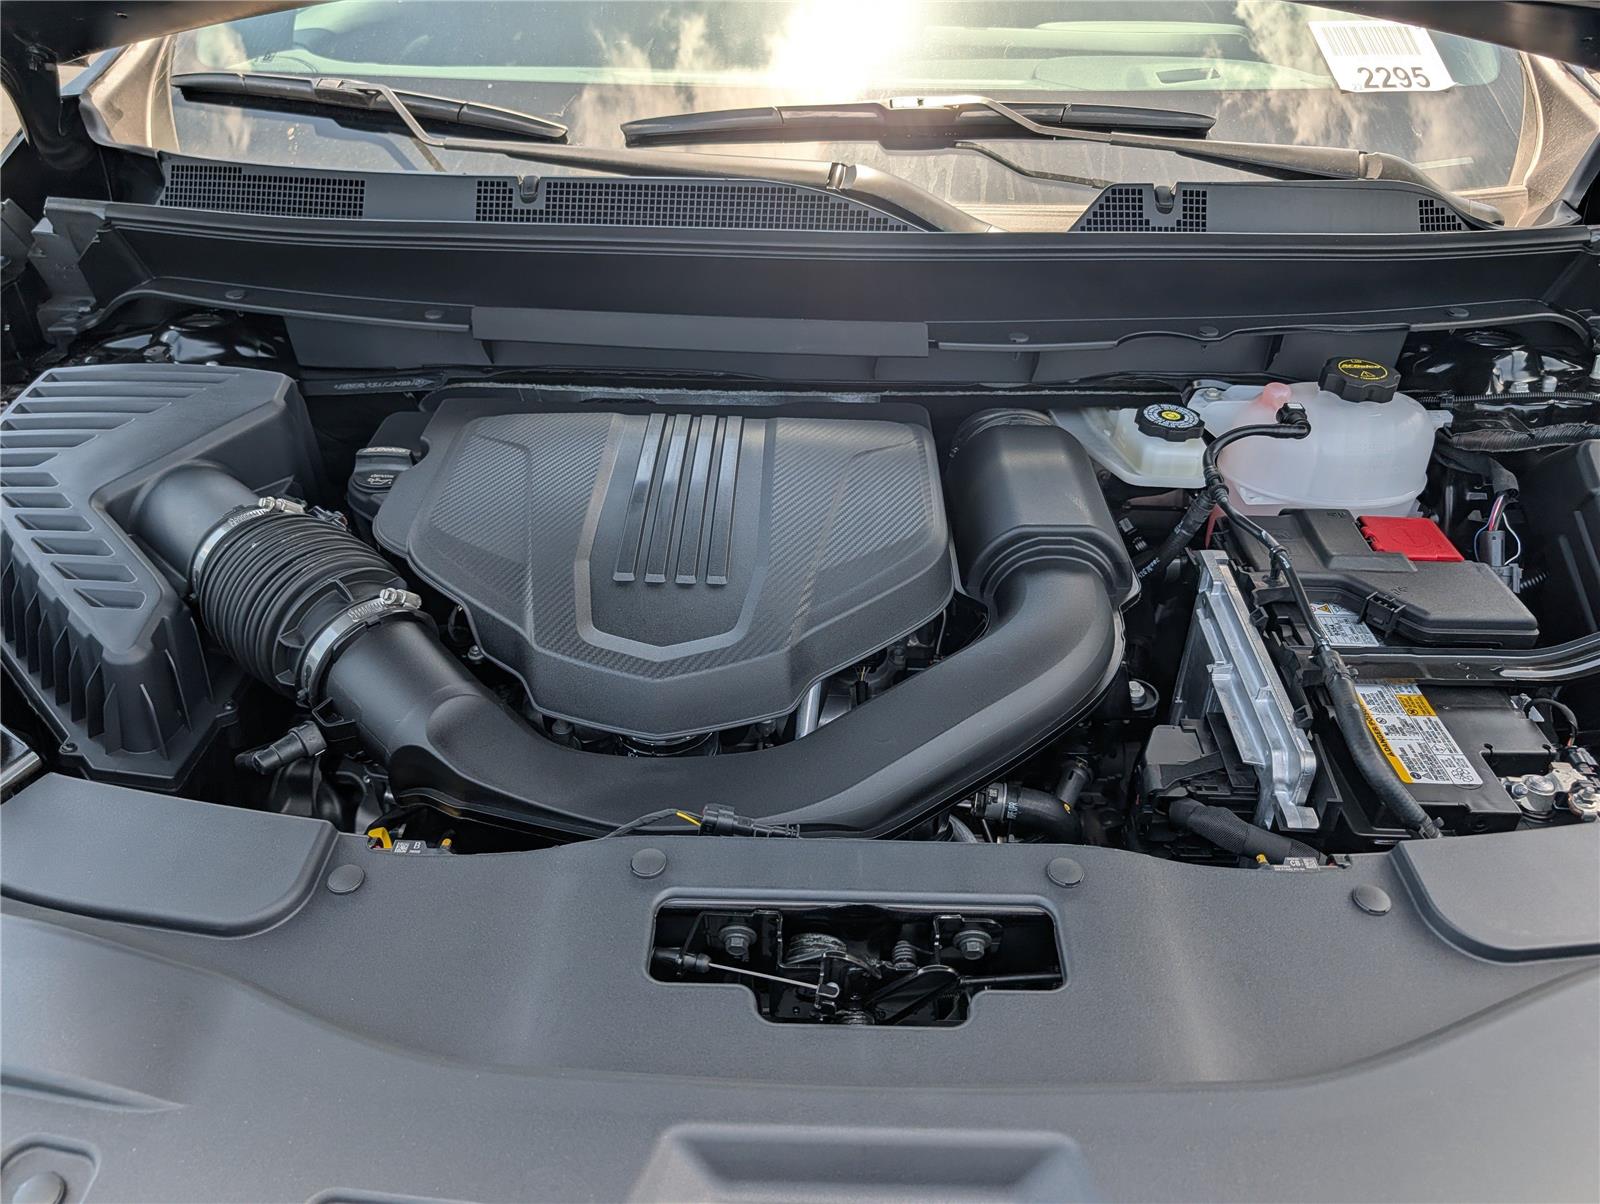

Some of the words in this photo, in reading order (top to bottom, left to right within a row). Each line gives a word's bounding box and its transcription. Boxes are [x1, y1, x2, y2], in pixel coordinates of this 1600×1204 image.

[1357, 67, 1431, 88] 2295
[1371, 726, 1391, 752] DANGER
[413, 841, 421, 849] B
